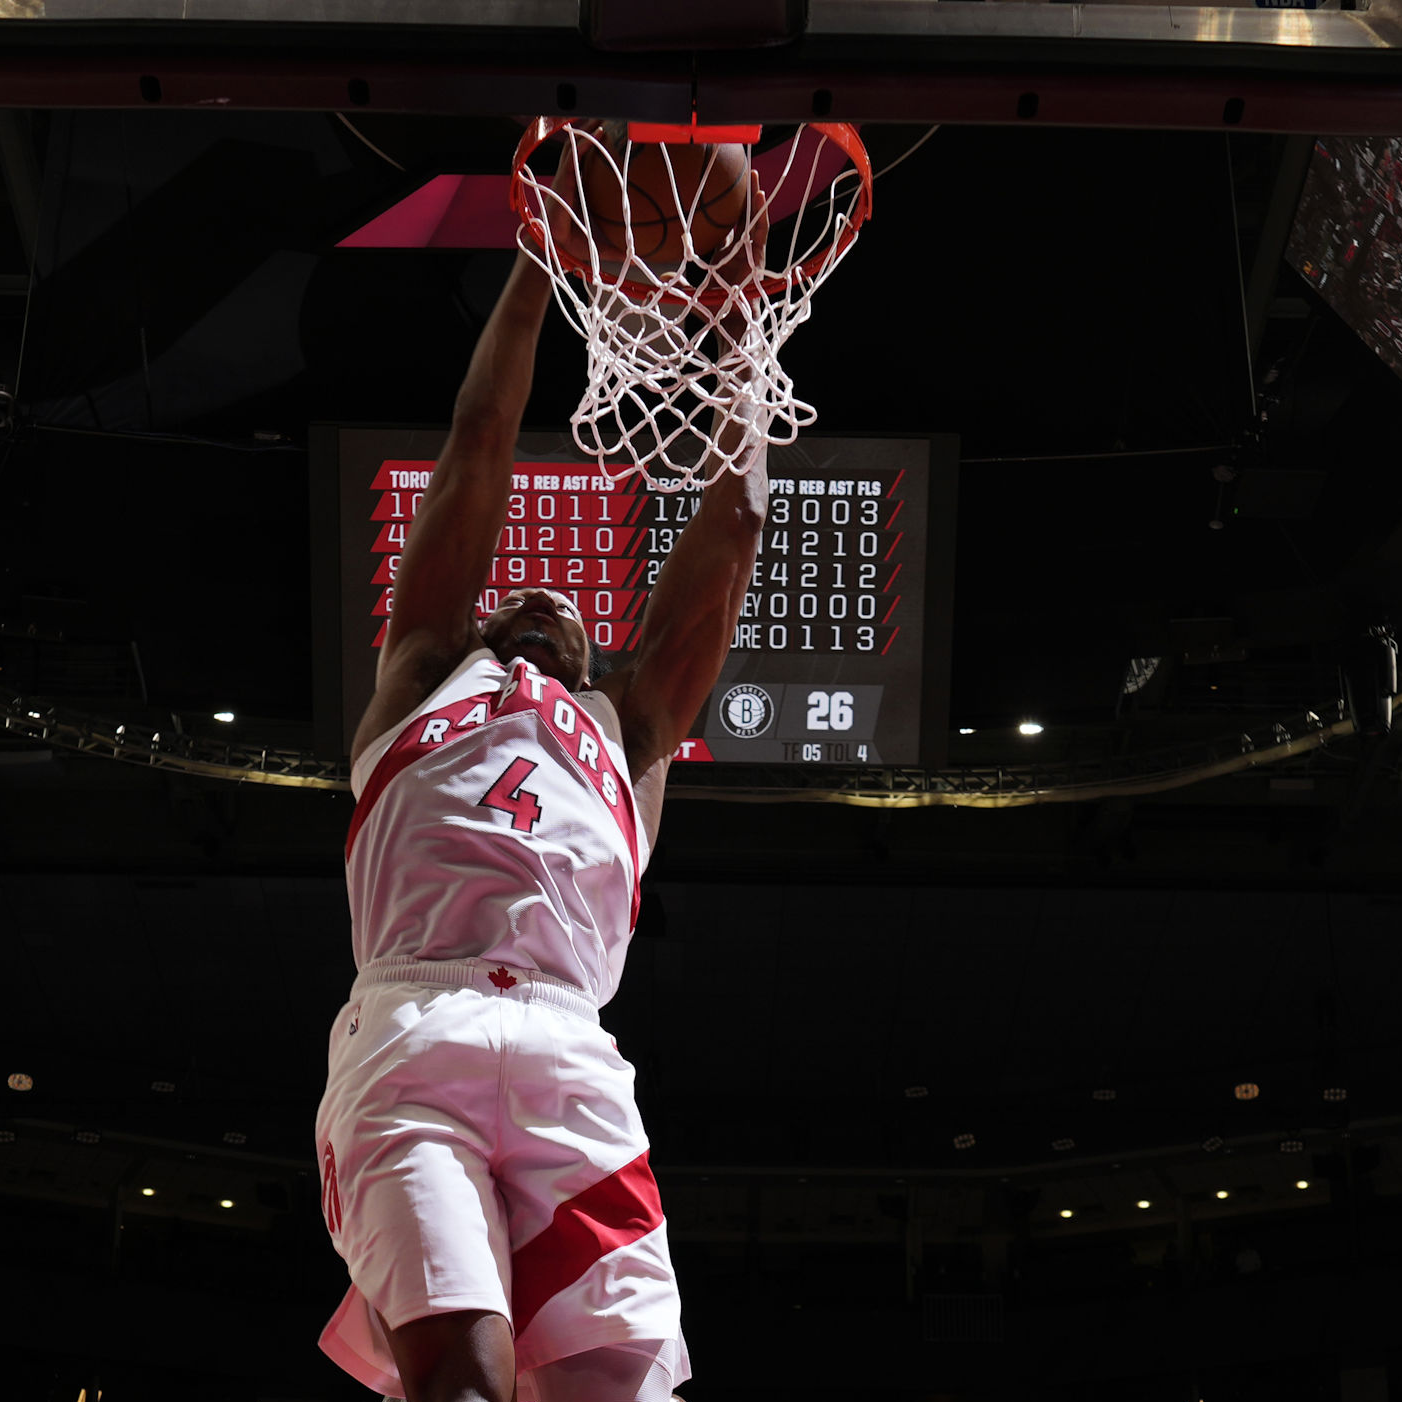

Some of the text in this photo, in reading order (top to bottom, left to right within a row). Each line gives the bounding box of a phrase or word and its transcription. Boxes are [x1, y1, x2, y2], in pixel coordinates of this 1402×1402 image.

[390, 470, 615, 491] TORO TS REB AST FLS
[769, 479, 795, 495] PTS
[799, 480, 825, 496] REB
[828, 480, 854, 496] AST
[857, 481, 881, 496] FLS
[508, 495, 525, 519] 3
[538, 495, 555, 520] 0
[569, 496, 582, 520] 1
[599, 496, 611, 520] 1
[655, 497, 668, 521] 1
[771, 499, 789, 523] 3
[802, 499, 820, 524] 0
[832, 500, 849, 524] 0
[860, 500, 878, 525] 3
[387, 524, 613, 551] 4 11 2 1 0
[771, 531, 789, 555] 4
[801, 531, 818, 556] 2
[833, 532, 846, 556] 1
[860, 532, 877, 557] 0
[508, 558, 525, 582] 9
[540, 558, 553, 582] 1
[567, 559, 583, 583] 2
[598, 559, 611, 583] 1
[770, 562, 788, 587] 4
[801, 563, 818, 587] 2
[832, 563, 845, 588] 1
[859, 564, 876, 588] 2
[595, 590, 612, 615] 0
[769, 593, 787, 618] 0
[800, 594, 817, 618] 0
[829, 594, 847, 619] 0
[858, 595, 875, 619] 0
[595, 622, 612, 646] 0
[769, 625, 787, 649] 0
[801, 626, 814, 650] 1
[831, 626, 844, 650] 1
[857, 626, 874, 651] 3
[807, 691, 854, 730] 26
[419, 671, 618, 807] RAPTORS
[802, 743, 821, 761] 05
[857, 744, 868, 762] 4
[478, 756, 542, 833] 4
